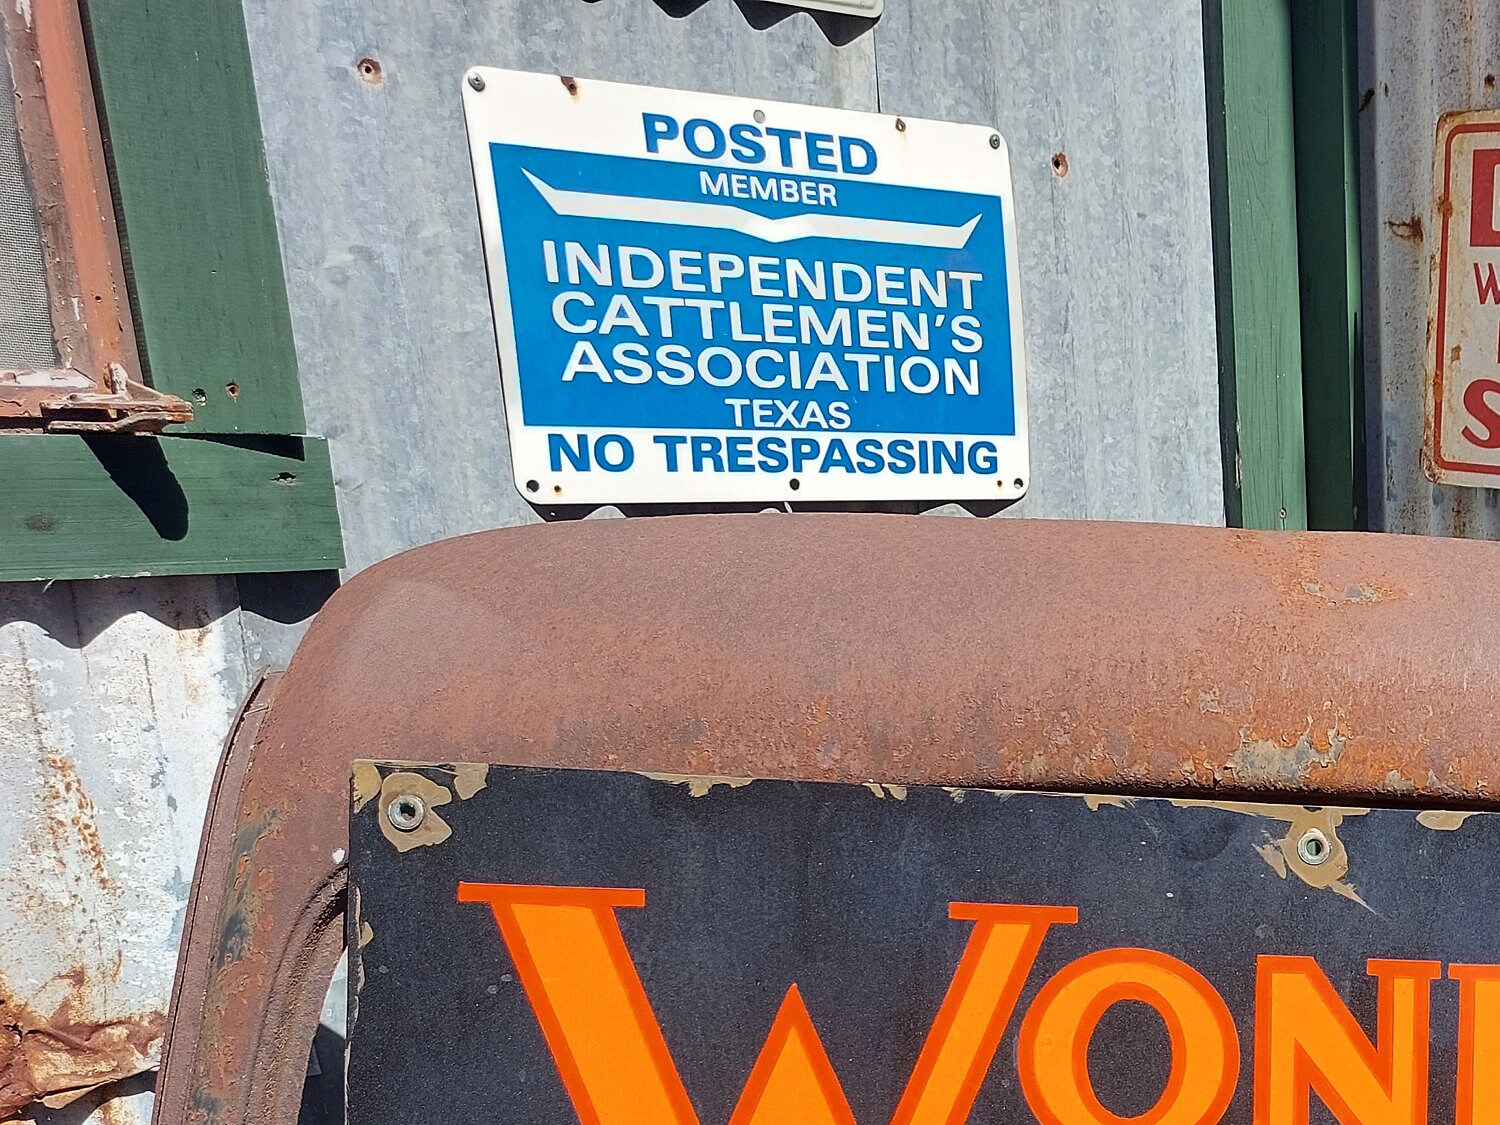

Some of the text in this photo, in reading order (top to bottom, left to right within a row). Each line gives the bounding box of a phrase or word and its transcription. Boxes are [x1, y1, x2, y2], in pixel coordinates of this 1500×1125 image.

[642, 112, 878, 175] POSTED
[699, 170, 838, 207] MEMBER
[543, 239, 983, 310] INDEPENDENT
[551, 291, 982, 353] CATTLEMEN'S
[560, 340, 980, 396] ASSOCIATION
[724, 397, 852, 430] TEXAS
[548, 433, 998, 475] NO TRESPASSING
